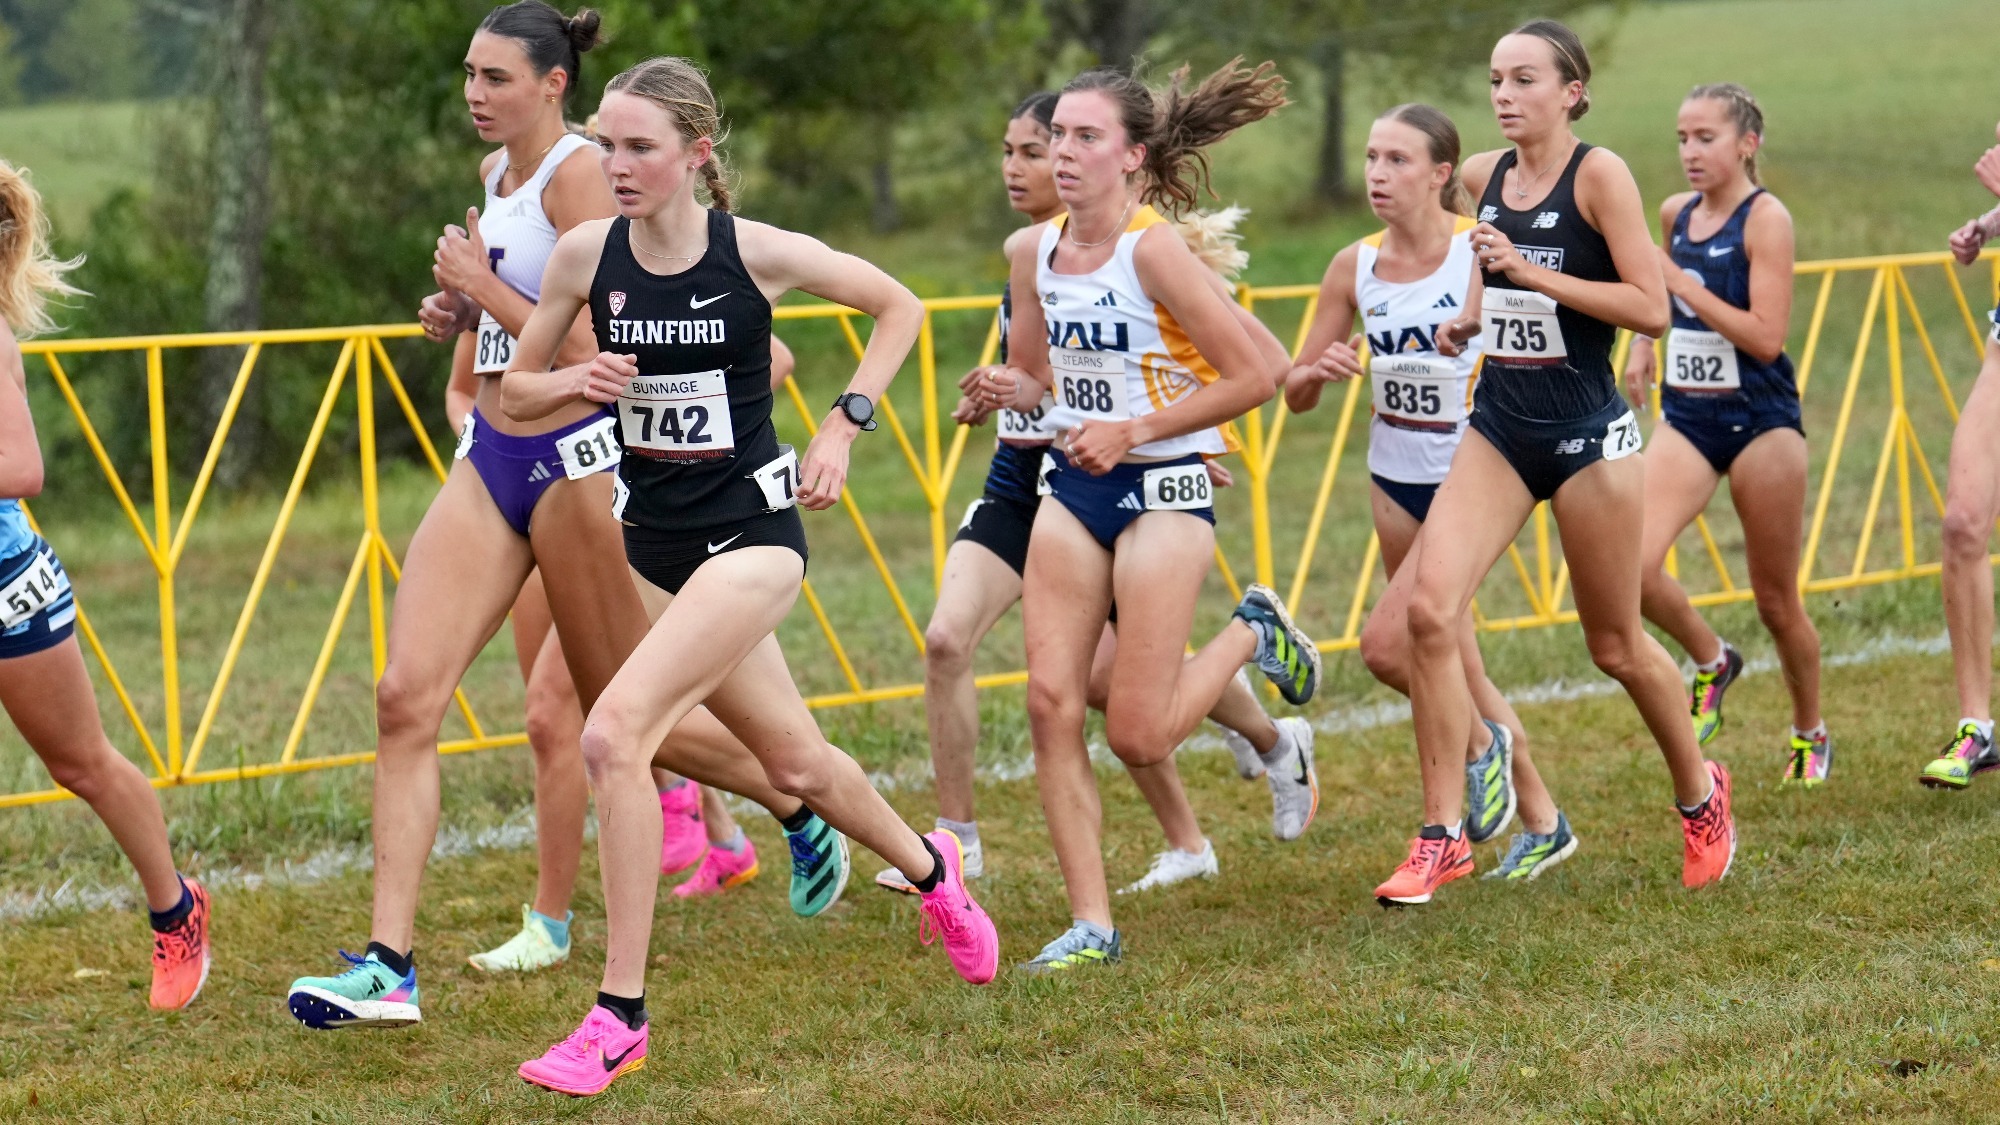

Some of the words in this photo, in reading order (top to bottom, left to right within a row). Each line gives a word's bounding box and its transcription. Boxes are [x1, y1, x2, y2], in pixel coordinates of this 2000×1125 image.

[1505, 296, 1525, 308] MAY
[609, 319, 726, 344] STANFORD
[1046, 320, 1129, 352] NAU
[1491, 317, 1547, 352] 735
[480, 330, 510, 366] 813
[1062, 354, 1104, 368] STEARNS
[1392, 362, 1431, 375] LARKIN
[1676, 354, 1725, 382] 582
[632, 381, 699, 395] BUNNAGE
[1063, 376, 1114, 413] 688
[1384, 380, 1441, 415] 835
[631, 405, 713, 444] 742
[668, 450, 725, 460] INVITATIONAL
[1158, 473, 1208, 503] 688
[7, 567, 55, 615] 514
